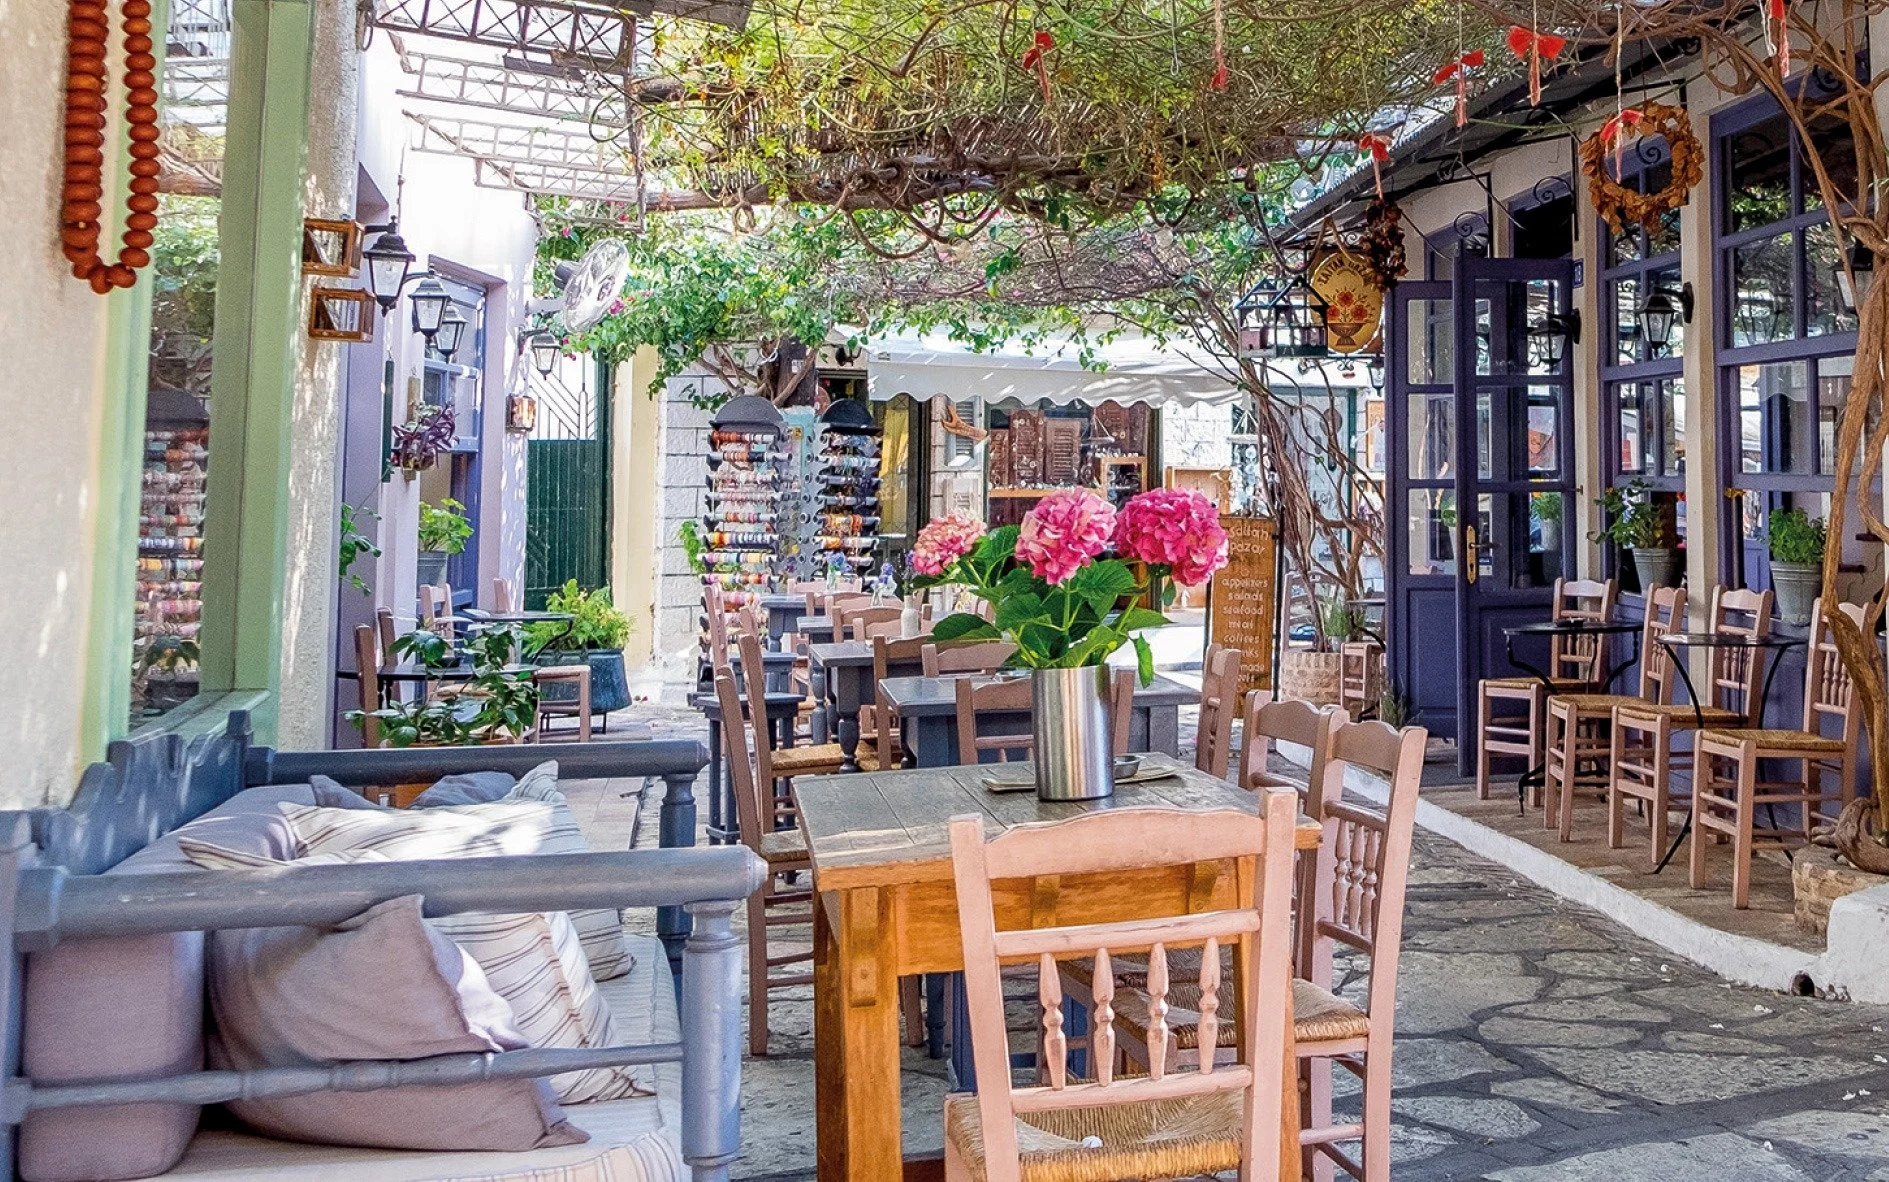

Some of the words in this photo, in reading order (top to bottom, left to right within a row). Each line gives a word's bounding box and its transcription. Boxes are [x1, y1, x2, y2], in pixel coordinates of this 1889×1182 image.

[1230, 541, 1265, 554] pazar
[1221, 578, 1268, 589] appetizers
[1228, 589, 1263, 601] salads
[1223, 604, 1263, 614] seafood
[1228, 620, 1253, 629] meat
[1223, 633, 1260, 644] coffees
